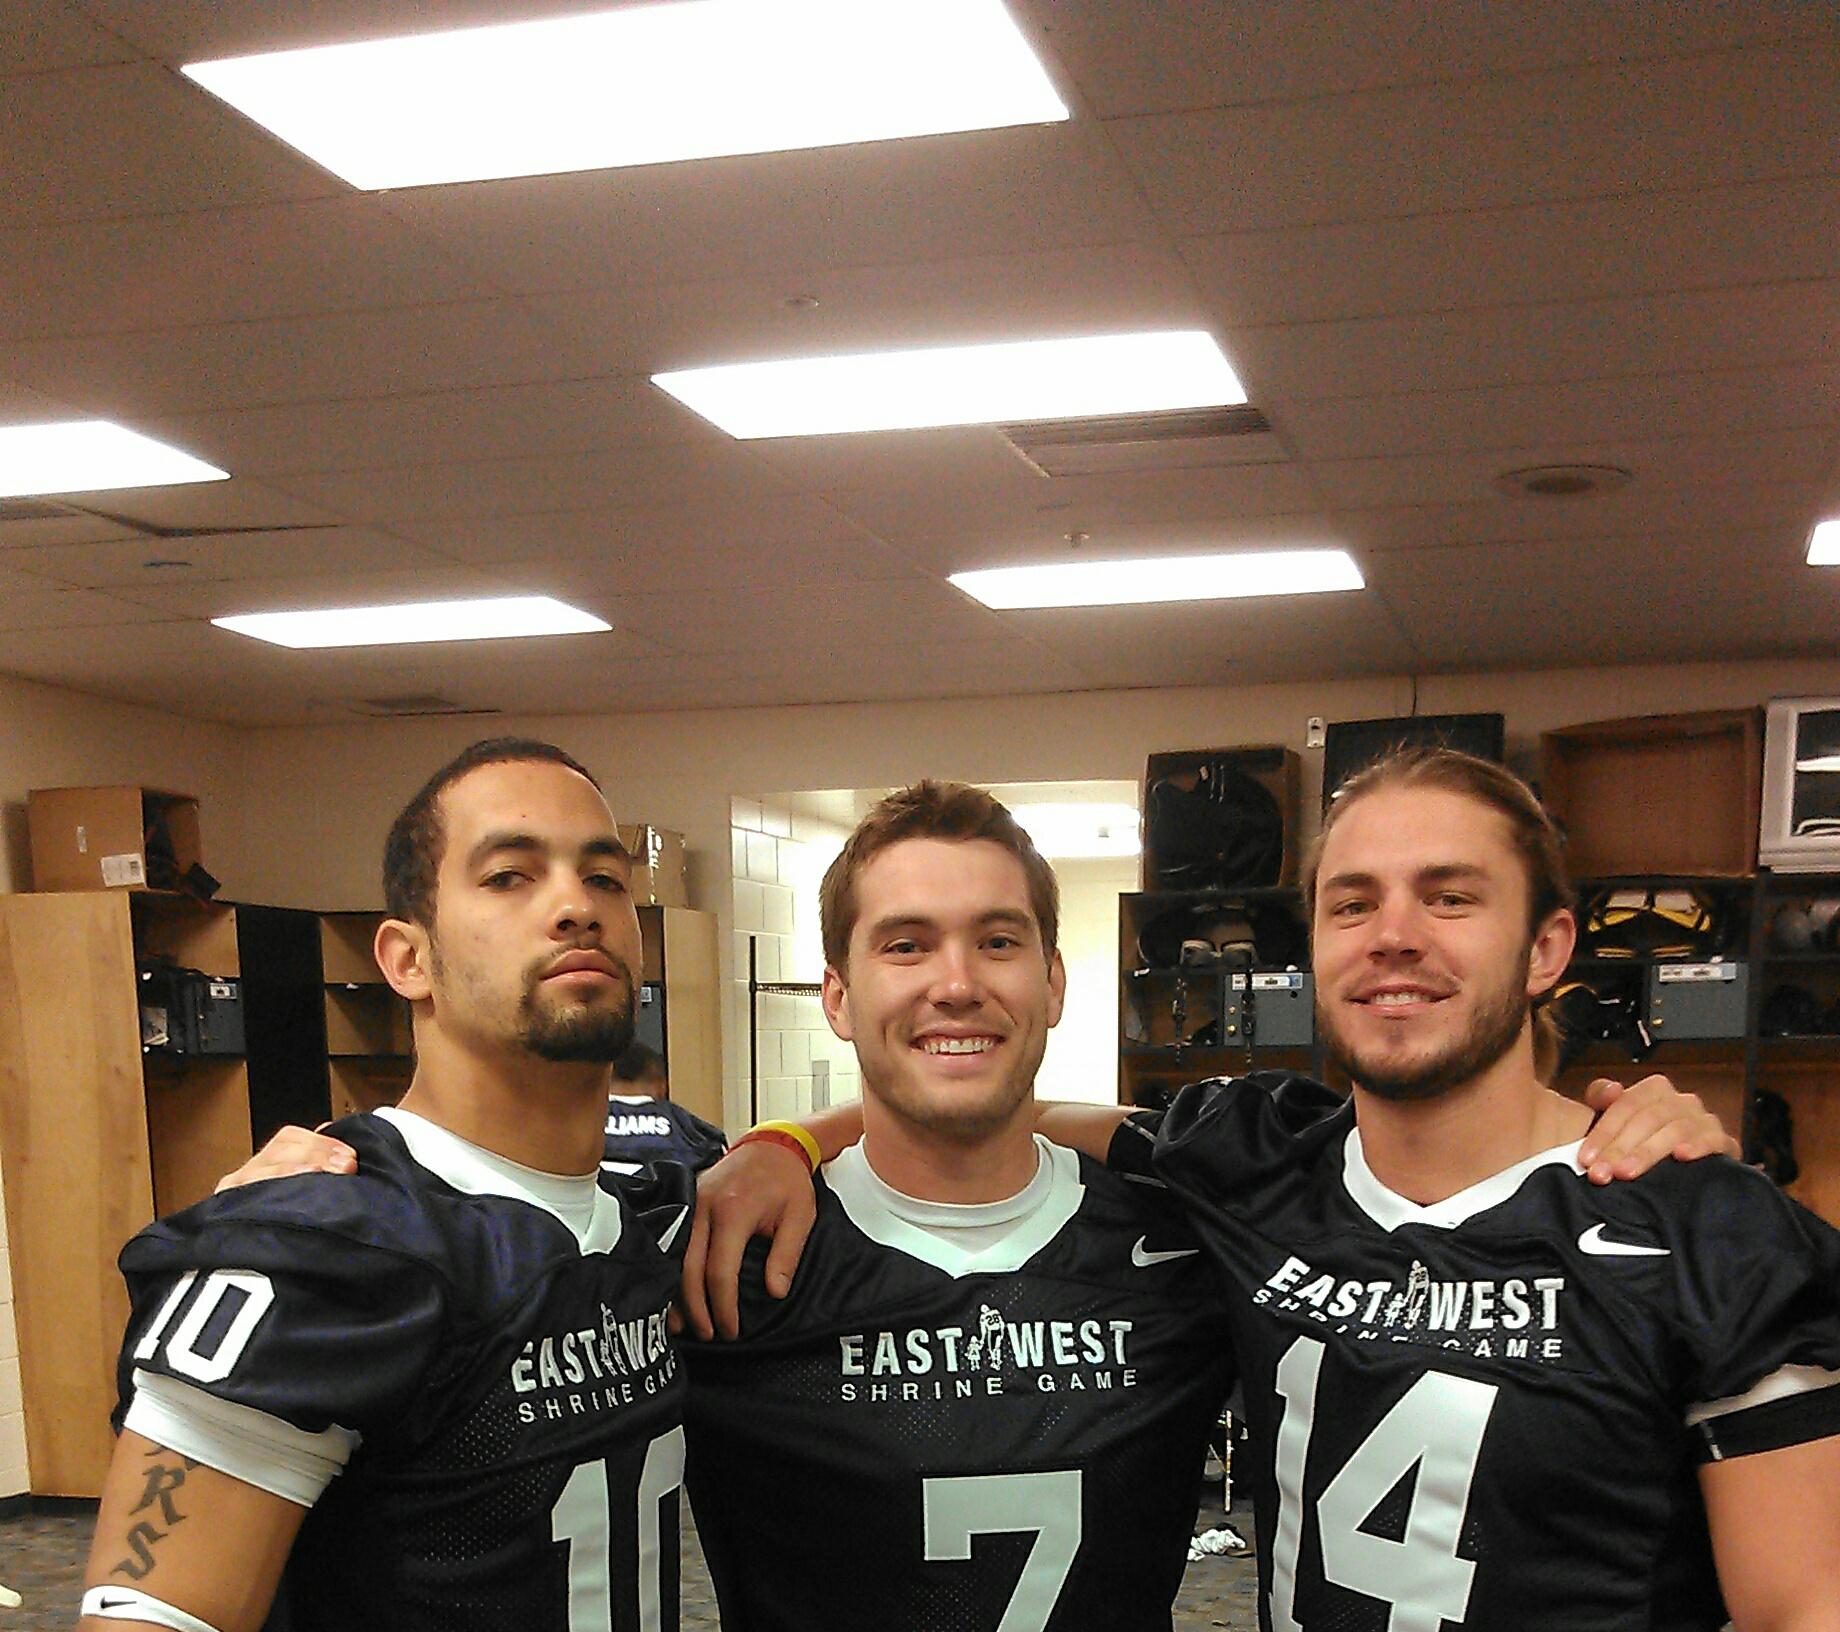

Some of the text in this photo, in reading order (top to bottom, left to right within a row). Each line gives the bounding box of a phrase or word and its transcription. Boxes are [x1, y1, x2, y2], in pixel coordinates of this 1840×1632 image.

[604, 1115, 671, 1136] LIAMS
[1253, 1289, 1409, 1343] SHRIN
[1266, 1256, 1565, 1332] EAST WEST
[133, 1268, 277, 1383] 10
[839, 1320, 1133, 1376] EAST WEST
[511, 1329, 604, 1393] EAST
[841, 1369, 1138, 1402] SHRINE GAME
[518, 1383, 634, 1423] SHRINE
